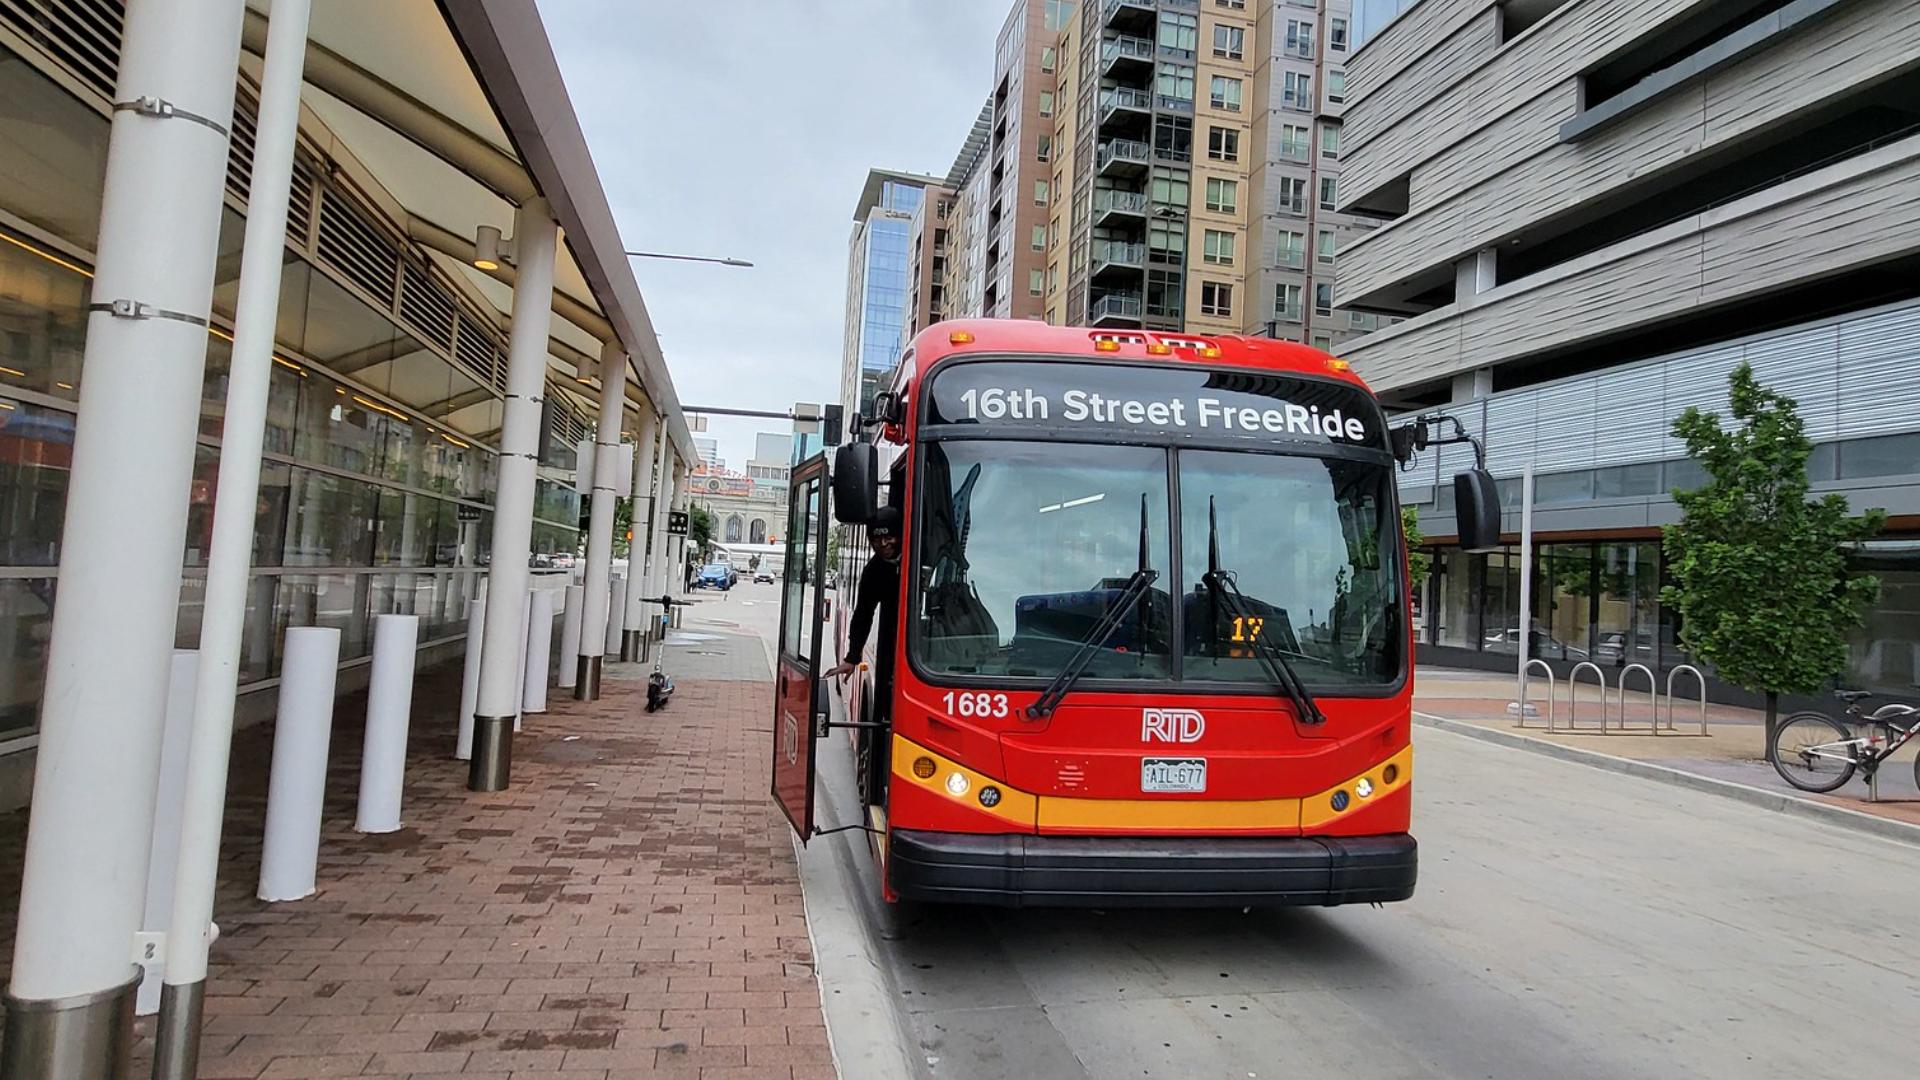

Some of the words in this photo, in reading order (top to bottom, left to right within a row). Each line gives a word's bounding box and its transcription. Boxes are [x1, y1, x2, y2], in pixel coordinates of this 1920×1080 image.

[960, 388, 1048, 419] 16th
[1063, 390, 1186, 427] Street
[1198, 398, 1365, 441] FreeRide
[943, 691, 1008, 718] 1683
[1141, 707, 1206, 743] RTD
